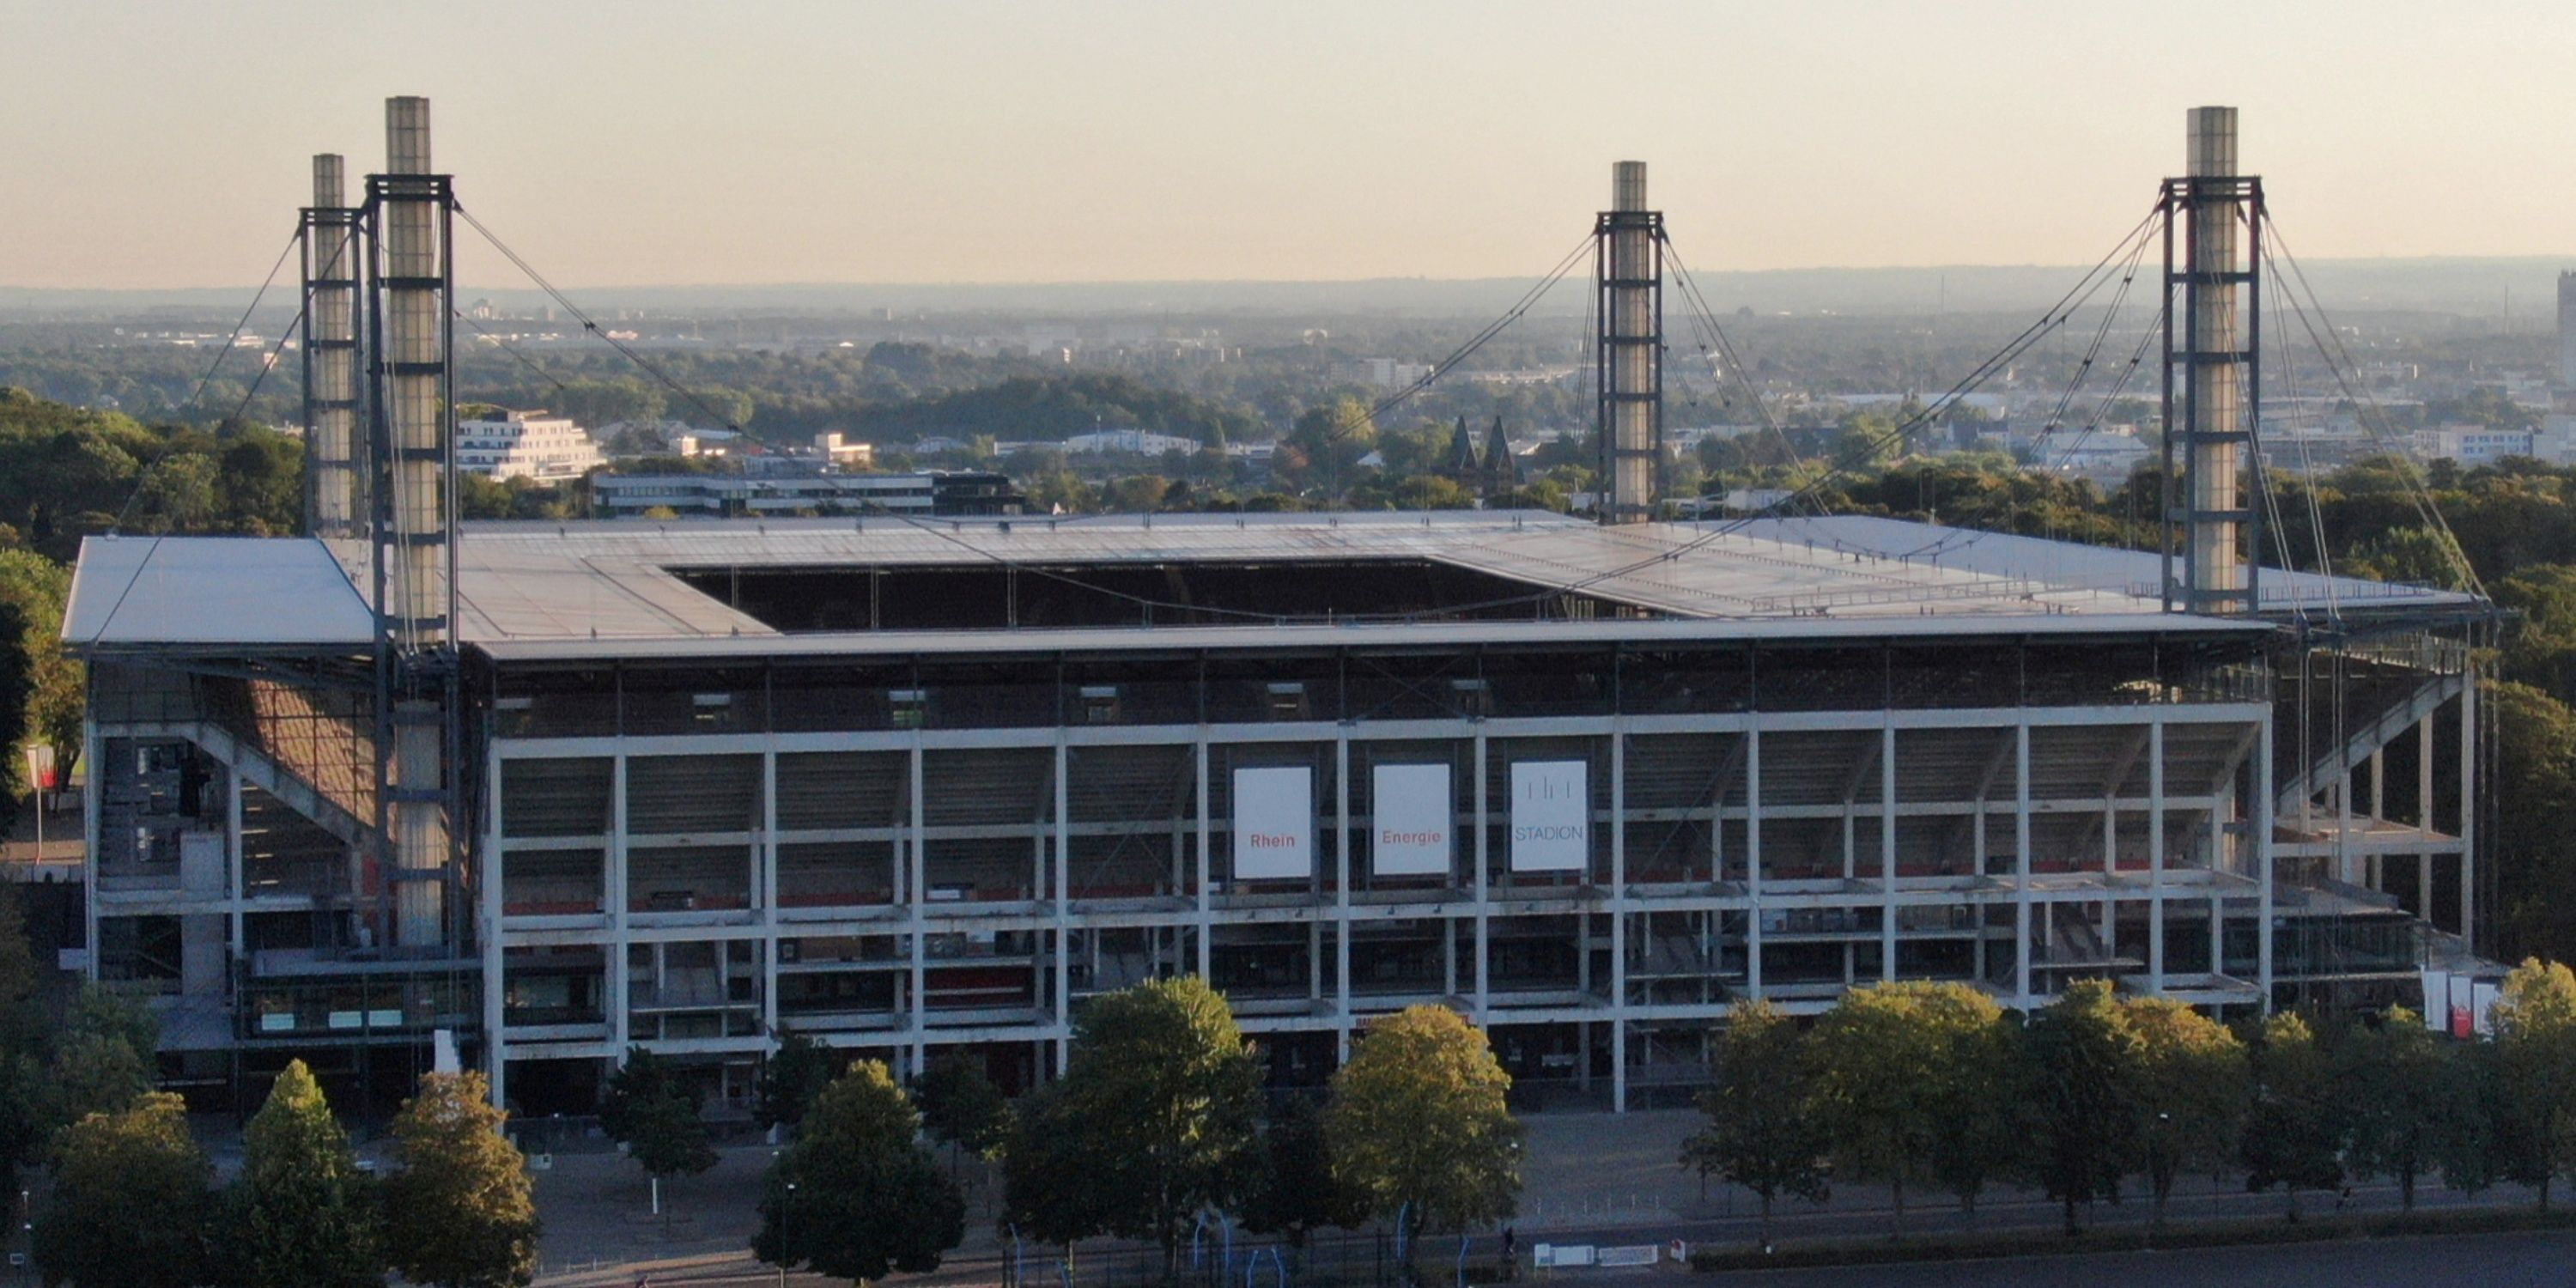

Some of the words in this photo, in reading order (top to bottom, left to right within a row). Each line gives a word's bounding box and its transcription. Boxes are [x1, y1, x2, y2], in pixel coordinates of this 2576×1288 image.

[1250, 833, 1295, 848] Rhein
[1382, 829, 1441, 847] Energie
[1515, 825, 1583, 841] STADION
